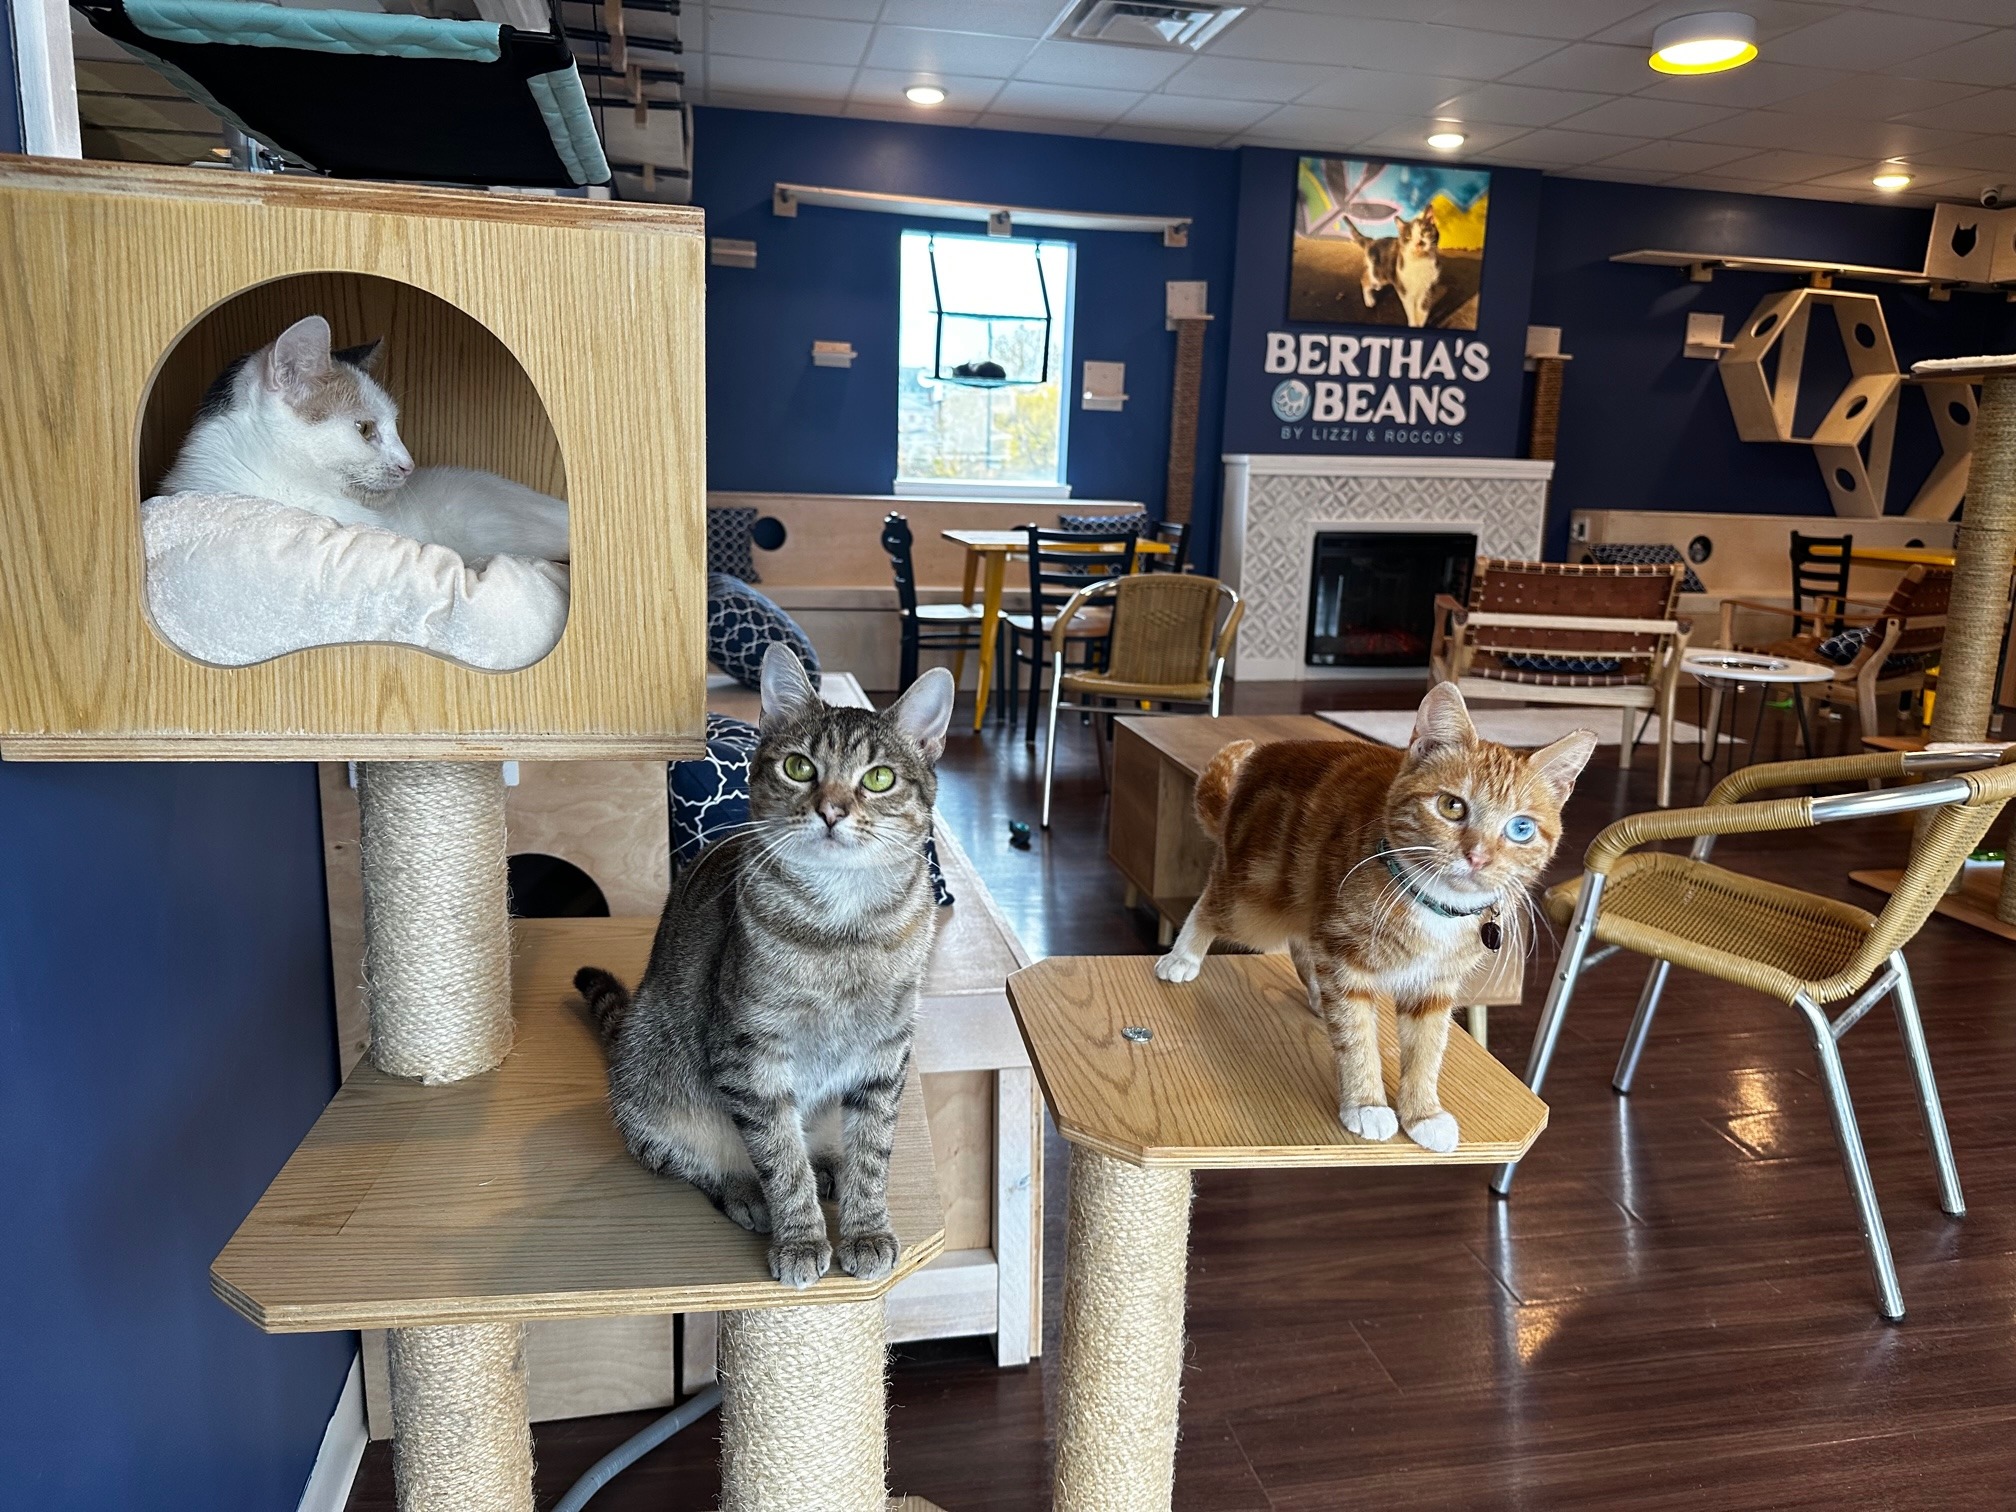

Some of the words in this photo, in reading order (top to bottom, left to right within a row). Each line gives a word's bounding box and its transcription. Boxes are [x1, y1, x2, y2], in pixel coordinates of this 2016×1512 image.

[1264, 331, 1491, 382] BERTHA'S
[1312, 381, 1467, 426] BEANS
[1280, 426, 1303, 440] BY
[1312, 428, 1358, 441] LIZZI
[1366, 429, 1376, 442] &
[1384, 429, 1464, 445] ROCCO'S
